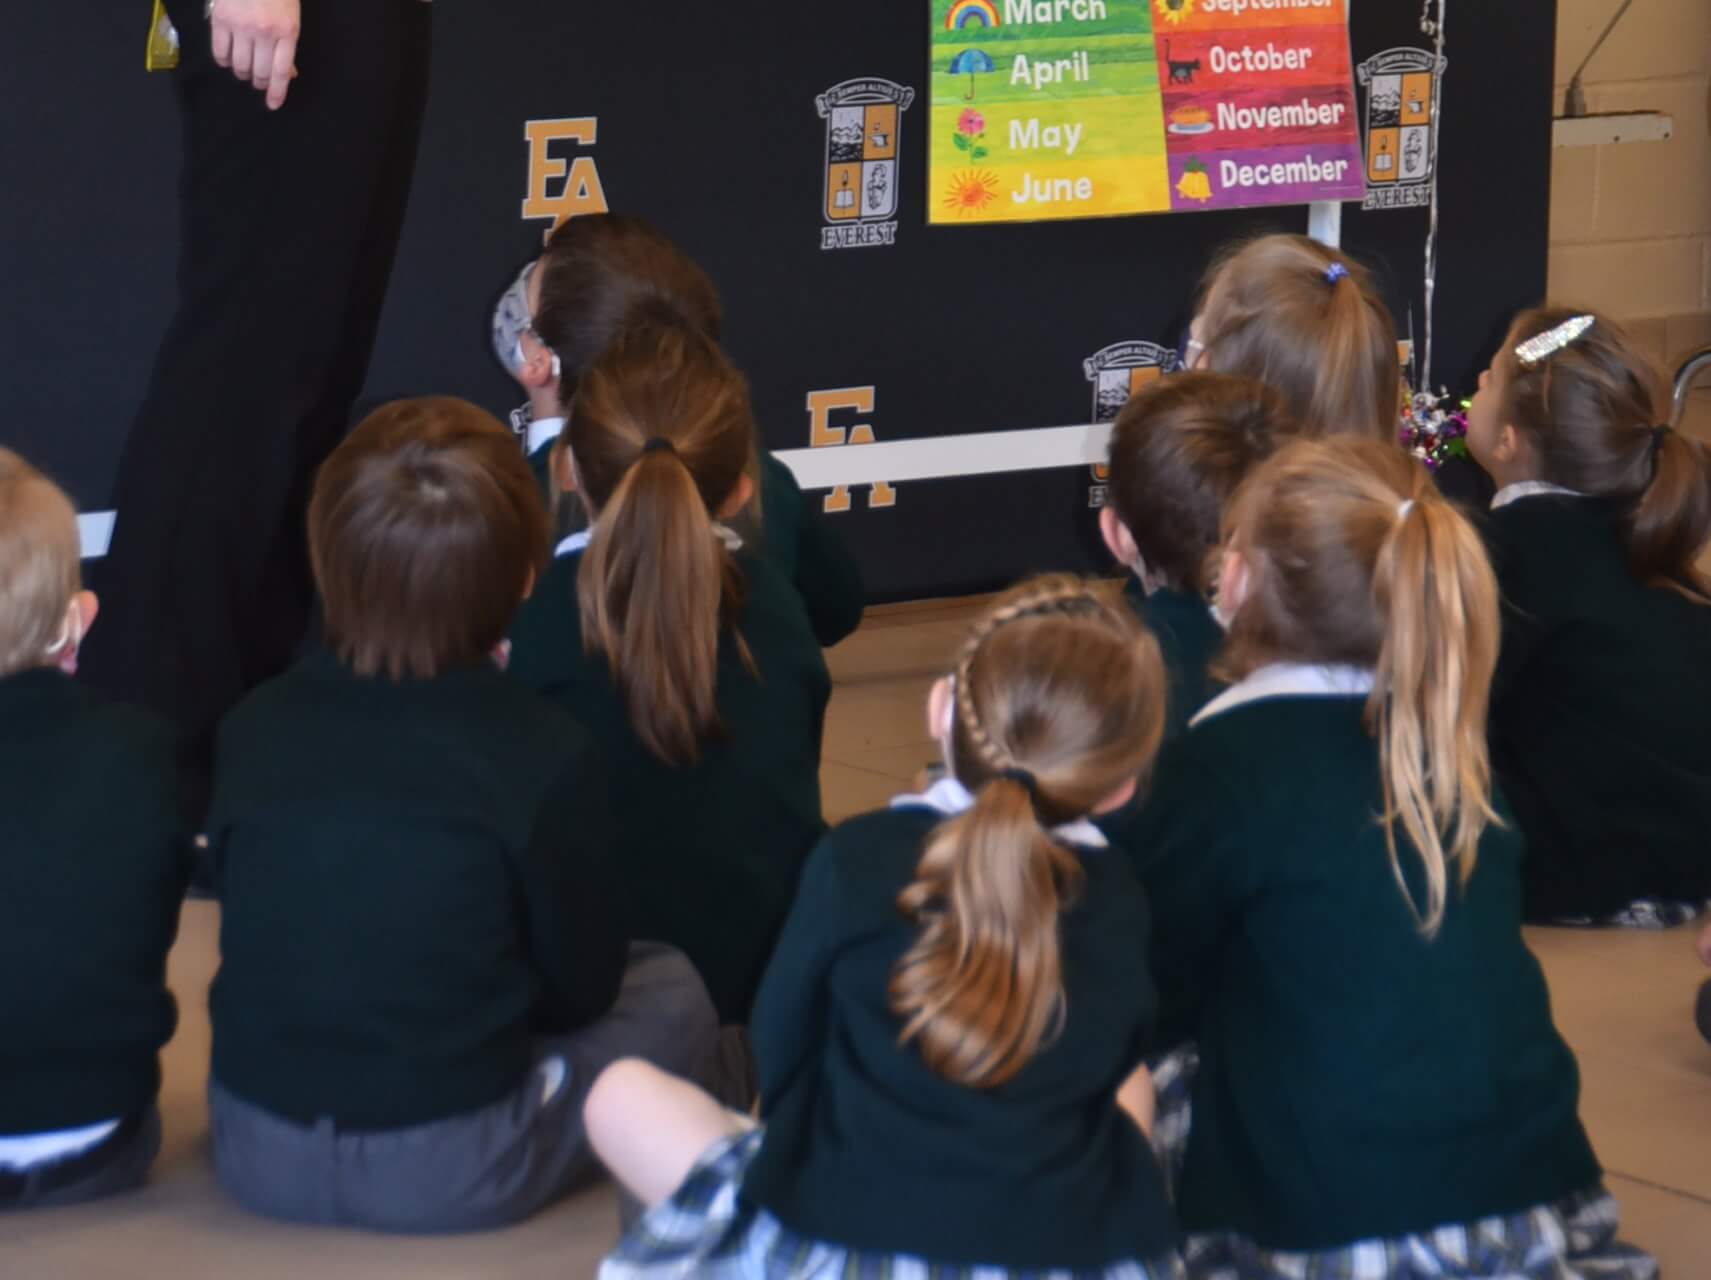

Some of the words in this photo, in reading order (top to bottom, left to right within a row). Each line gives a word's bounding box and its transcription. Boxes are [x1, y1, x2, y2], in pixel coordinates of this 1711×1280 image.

[1010, 50, 1090, 89] April
[1209, 45, 1312, 75] October
[1216, 99, 1346, 132] November
[1008, 118, 1083, 154] May
[1219, 156, 1349, 189] December
[1011, 173, 1093, 206] June
[1362, 184, 1432, 210] EVEREST
[821, 221, 898, 250] EVEREST
